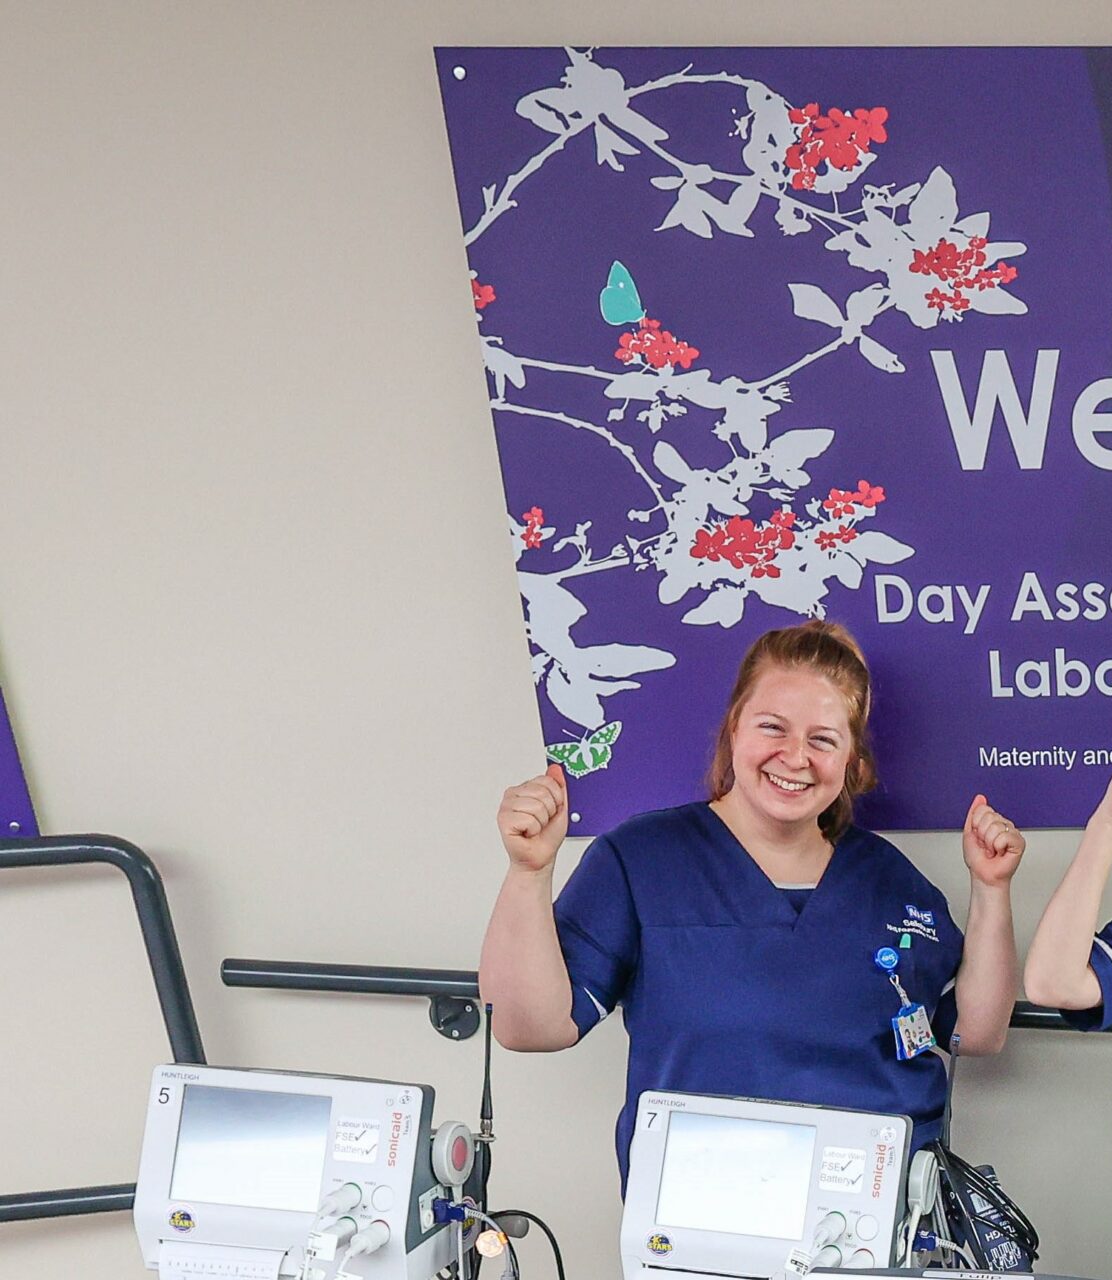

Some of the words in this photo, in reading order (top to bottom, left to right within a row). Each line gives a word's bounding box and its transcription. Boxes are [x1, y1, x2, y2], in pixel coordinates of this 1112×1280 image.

[875, 573, 991, 634] Day
[978, 744, 1077, 768] Maternity
[909, 908, 931, 922] NHS
[157, 1087, 170, 1105] 5
[646, 1113, 658, 1128] 7
[334, 1132, 355, 1142] FSE
[388, 1112, 402, 1167] sonicaid
[334, 1144, 366, 1156] Battery
[821, 1162, 841, 1172] FSE
[872, 1144, 886, 1198] sonicaid
[820, 1173, 852, 1186] Battery
[168, 1219, 197, 1230] STARS
[647, 1241, 672, 1252] STARS
